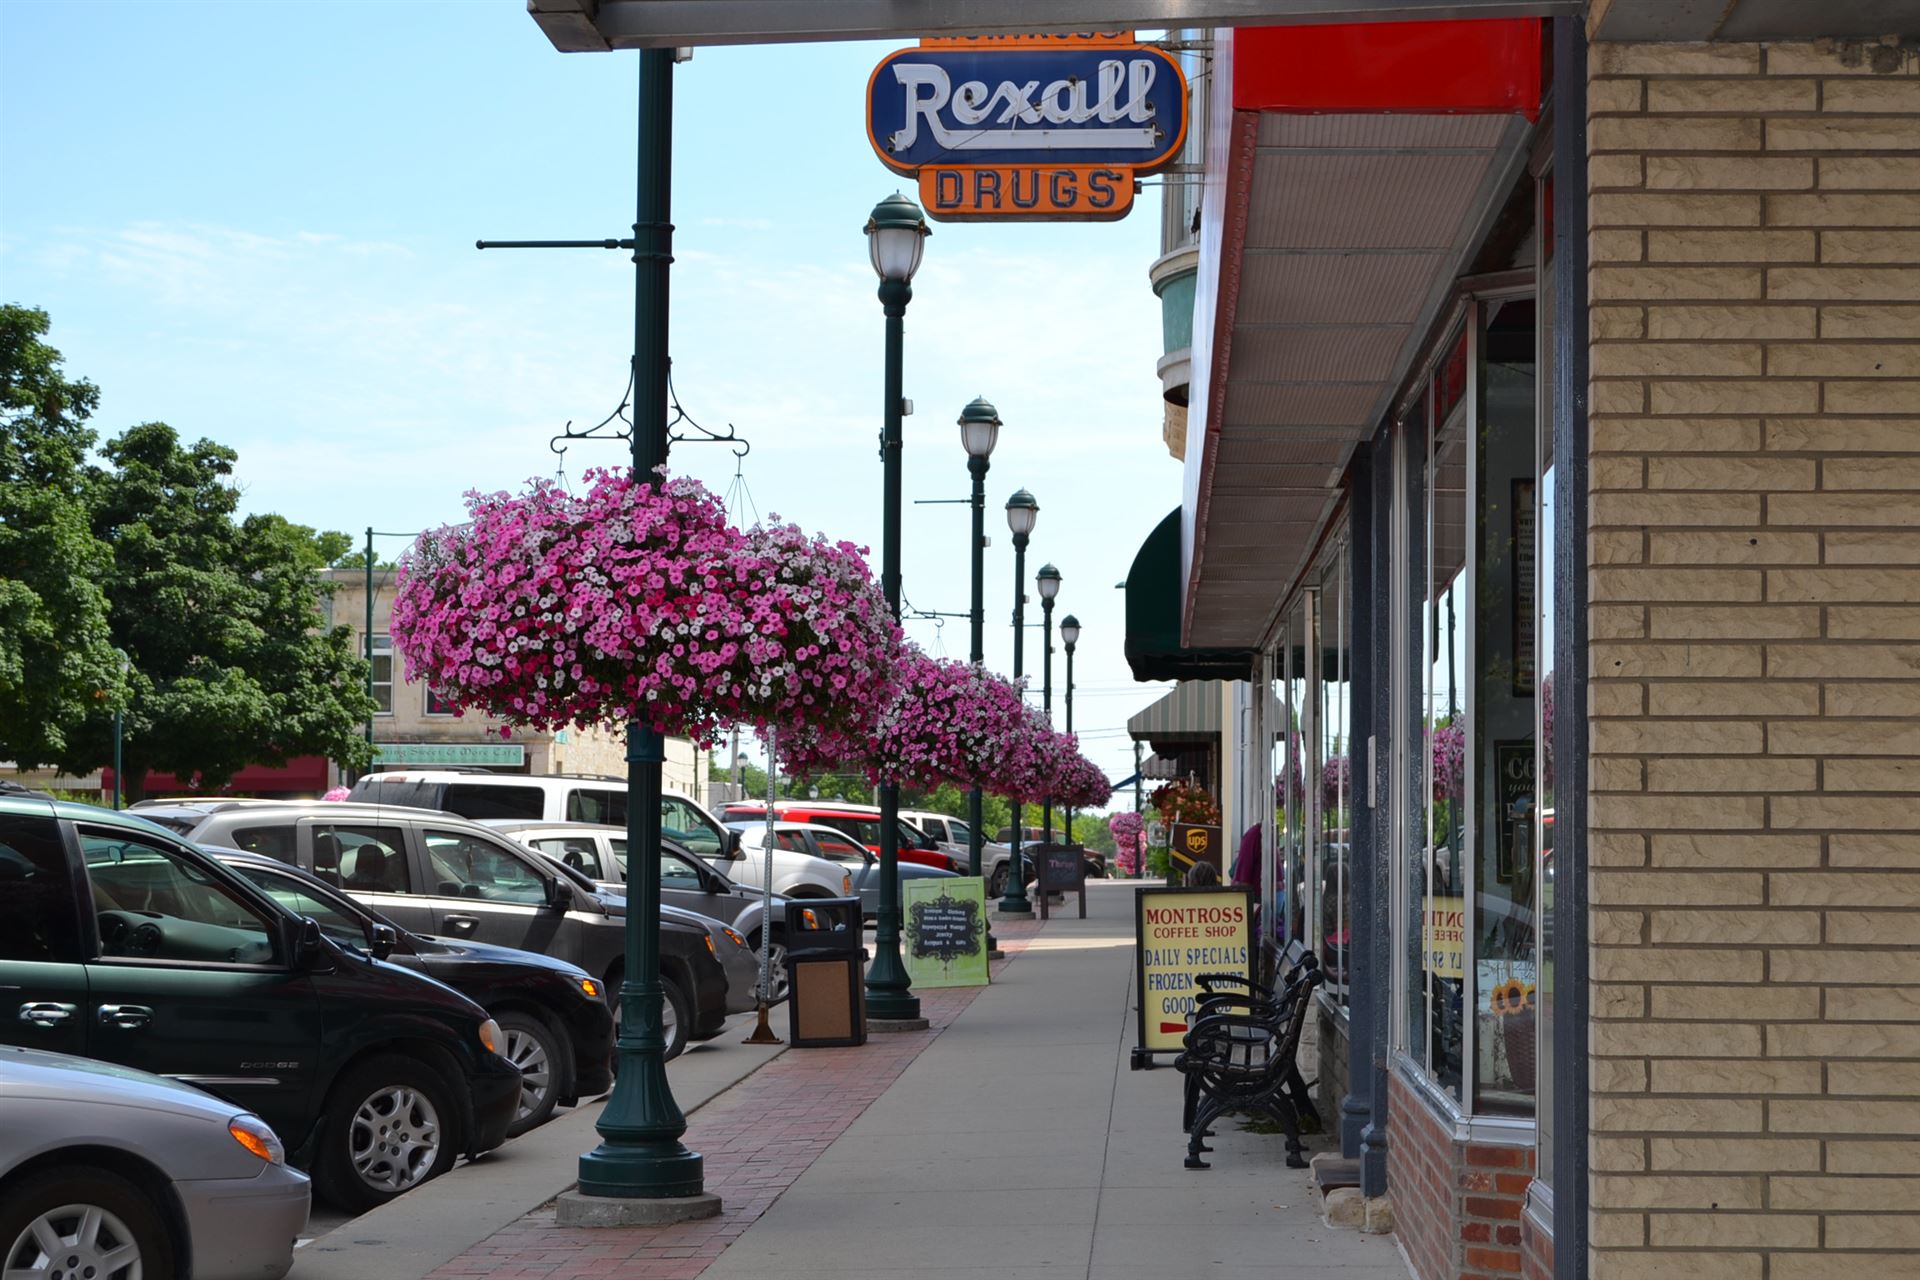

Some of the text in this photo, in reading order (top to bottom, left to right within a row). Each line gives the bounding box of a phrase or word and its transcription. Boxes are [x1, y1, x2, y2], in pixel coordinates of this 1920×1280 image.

[892, 60, 1156, 151] Rexall
[935, 170, 1117, 208] DRUGS
[1189, 835, 1206, 849] ups
[1146, 907, 1244, 924] MONTROSS
[1154, 926, 1237, 939] COFFEE SHOP
[1145, 947, 1247, 966] DAILY SPECIALS
[1148, 973, 1193, 990] FROZEN
[1162, 997, 1195, 1014] GOOD
[240, 1061, 299, 1069] DODGE
